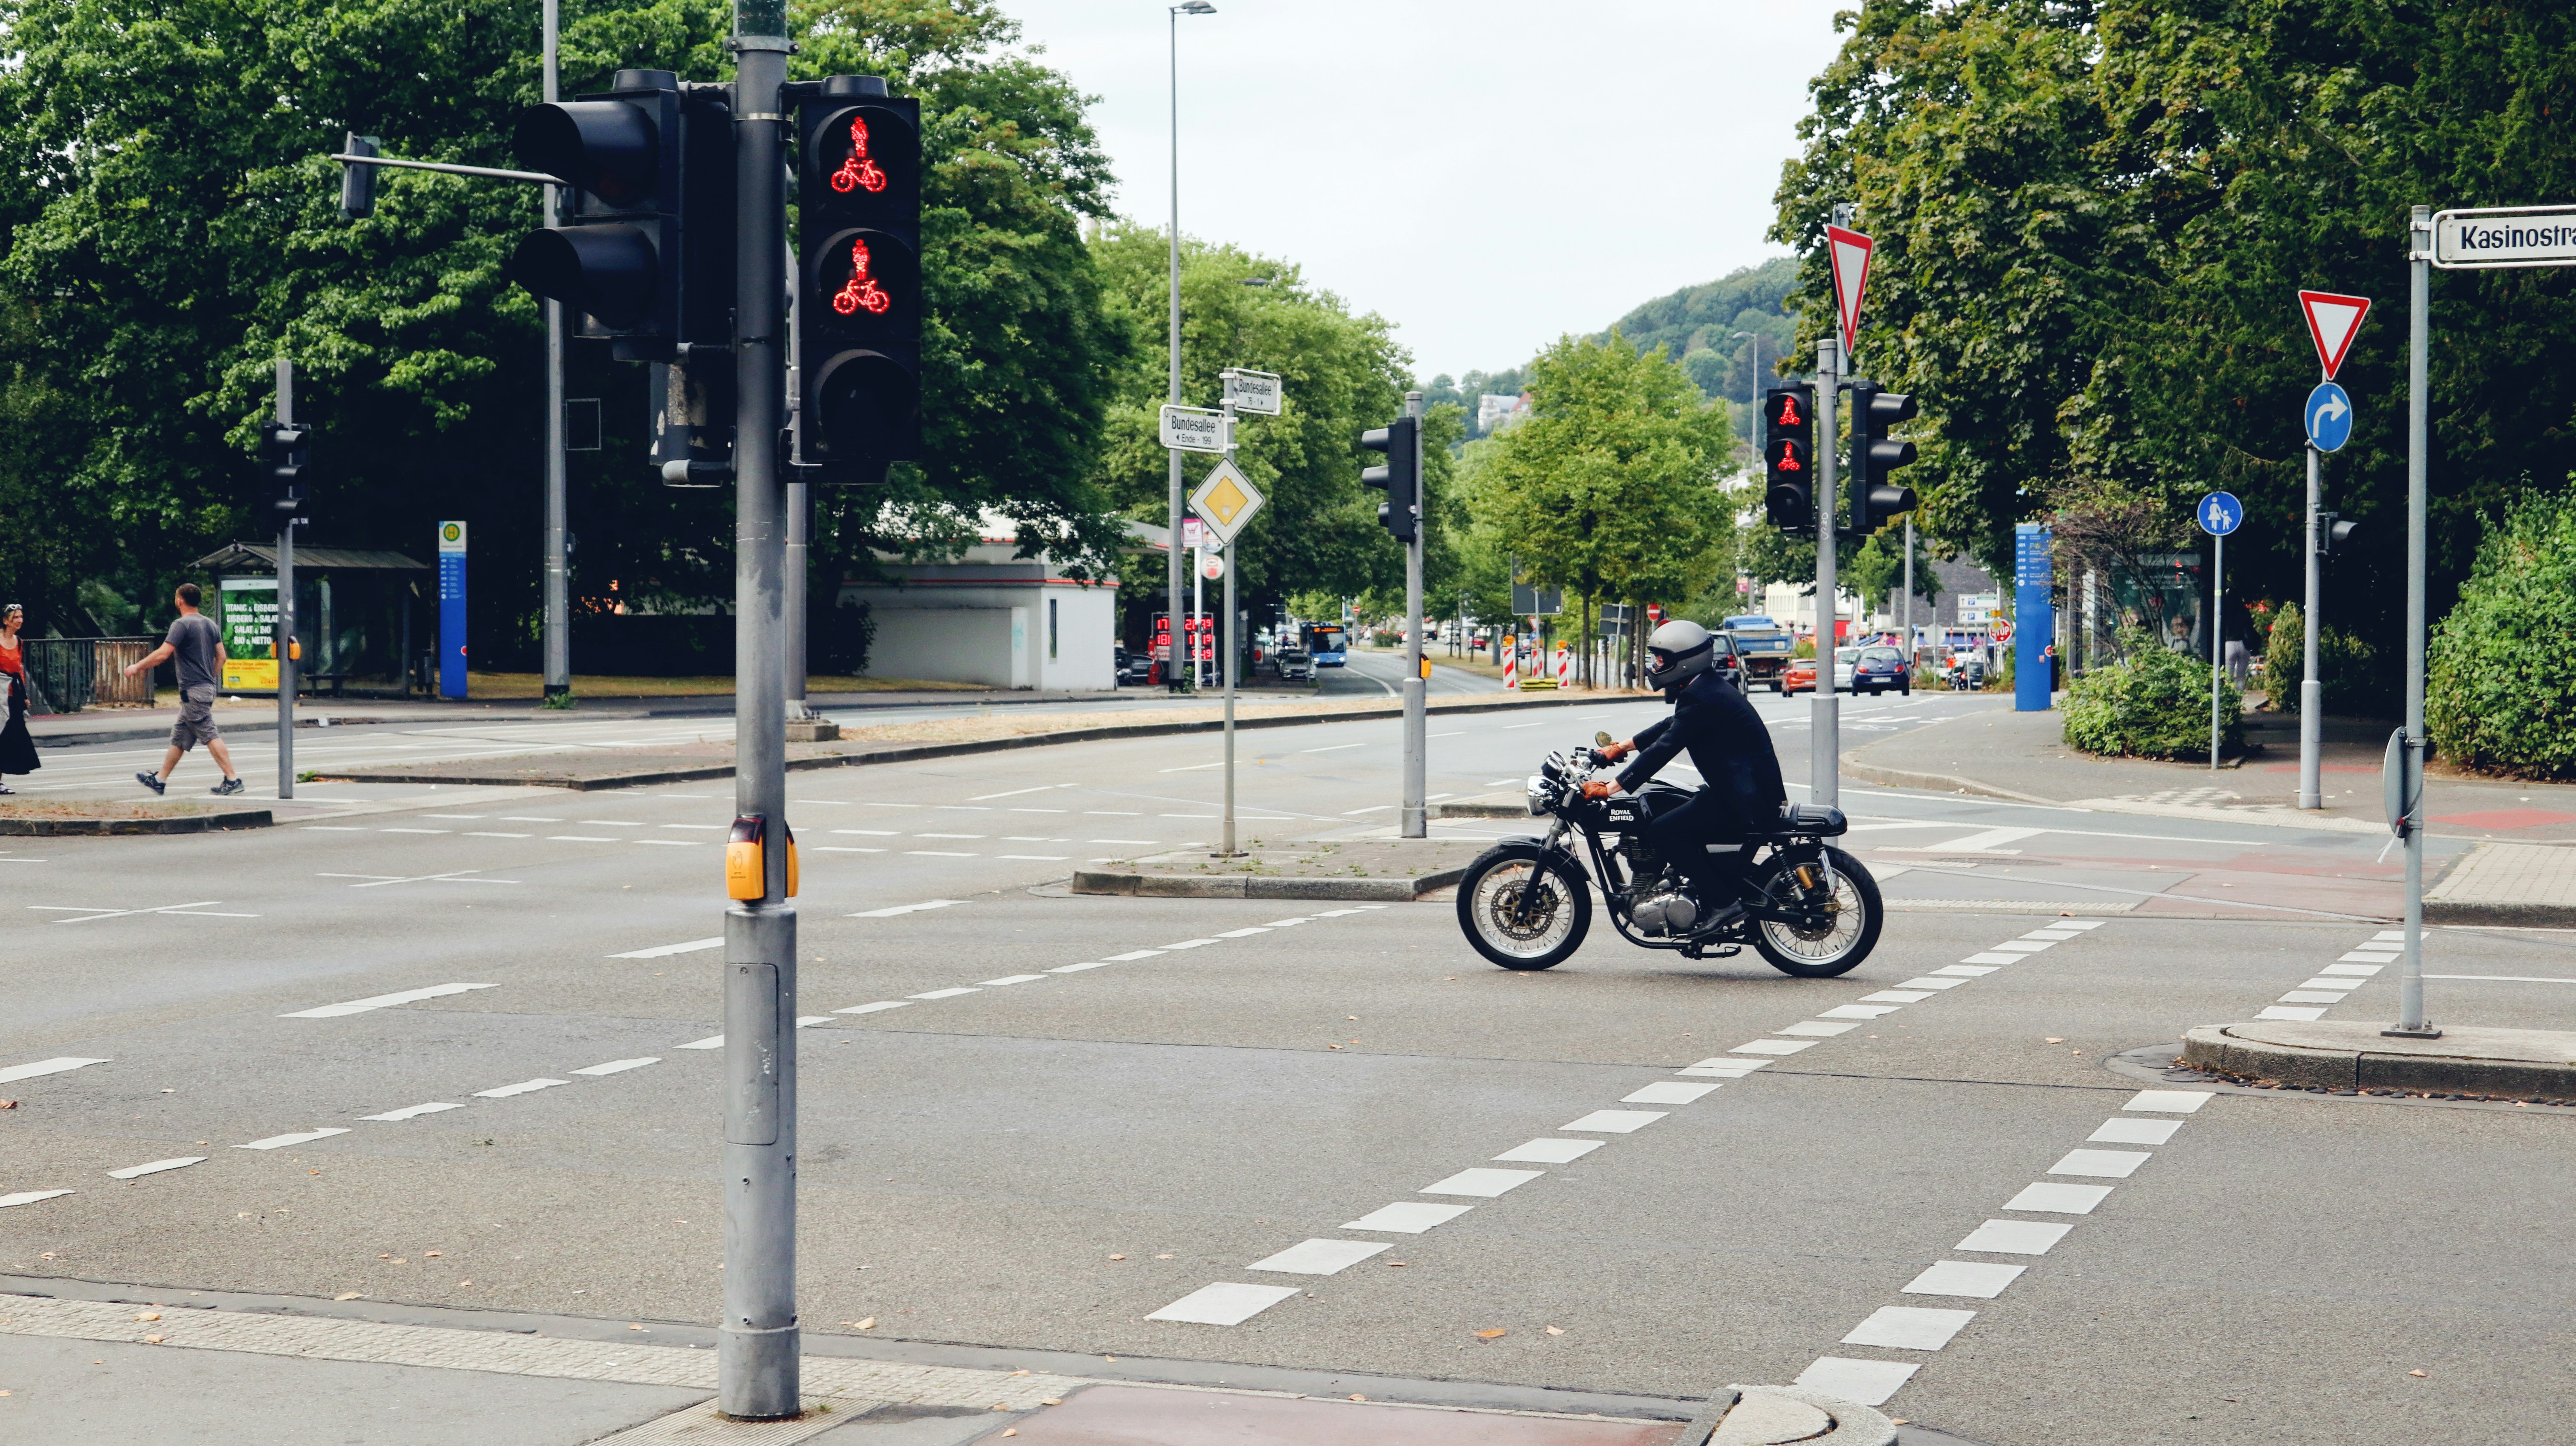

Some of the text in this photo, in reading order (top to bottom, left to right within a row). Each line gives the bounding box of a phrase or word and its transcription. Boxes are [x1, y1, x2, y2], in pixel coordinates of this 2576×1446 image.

[1239, 378, 1271, 396] Bundesallee
[1172, 415, 1215, 433] Bundesallee
[1182, 434, 1195, 443] Ende
[1202, 436, 1212, 444] 199
[225, 604, 247, 612] TITANIC
[226, 614, 253, 623] EISBERG
[259, 614, 279, 623] SALAT
[234, 625, 253, 634] SALAT
[259, 626, 272, 634] BIO
[234, 636, 245, 644] BIO
[251, 636, 272, 645] NETTO
